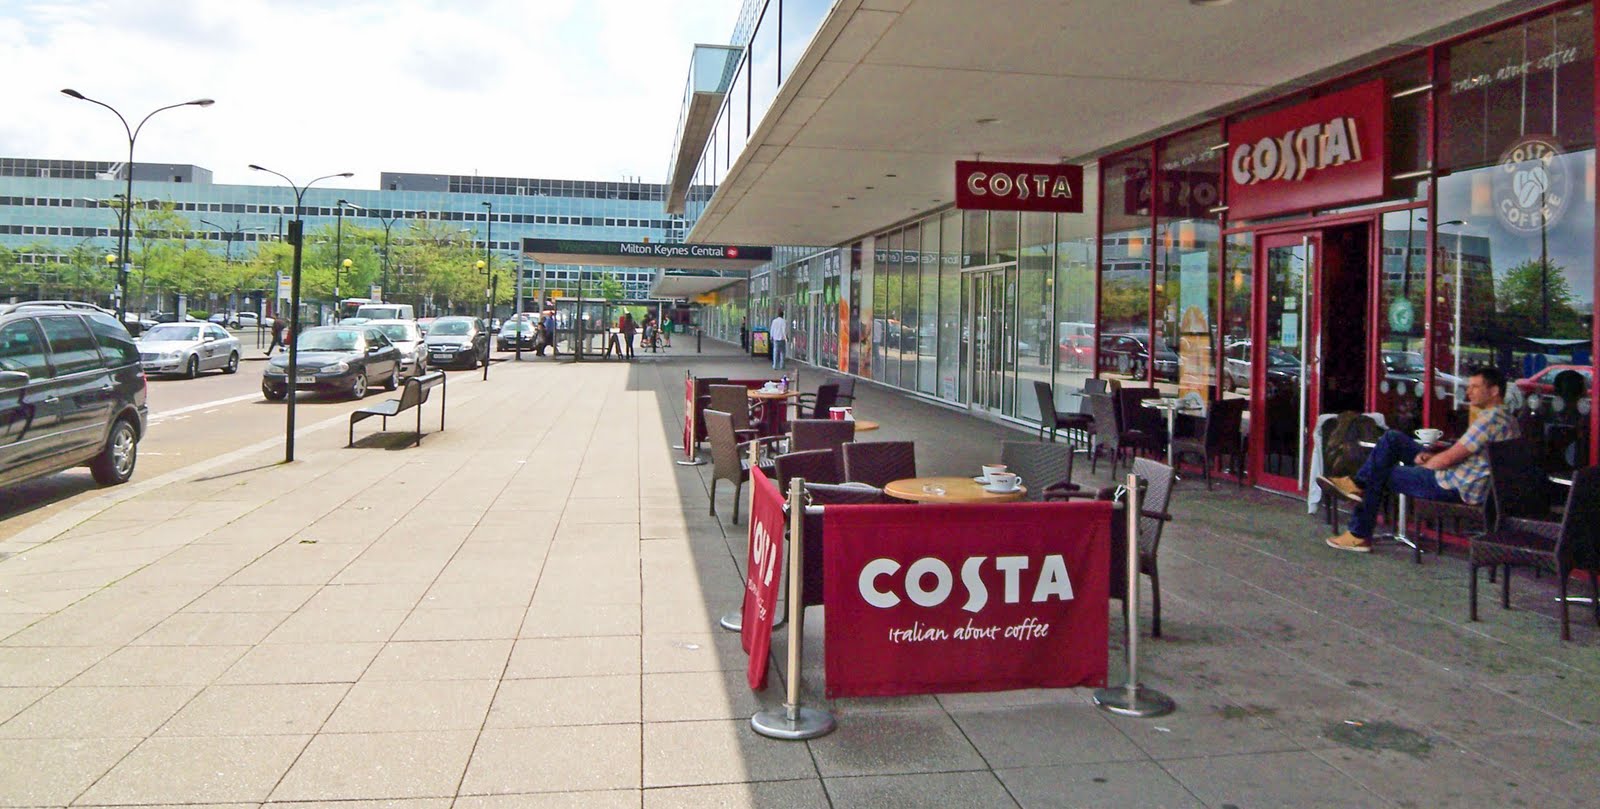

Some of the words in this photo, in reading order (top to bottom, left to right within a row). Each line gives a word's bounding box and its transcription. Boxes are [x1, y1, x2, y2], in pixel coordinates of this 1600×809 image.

[1231, 116, 1357, 185] COSTA
[1503, 144, 1555, 173] COSTA
[967, 171, 1072, 200] COSTA
[1501, 193, 1561, 227] COFFEE
[620, 243, 652, 254] Milton
[654, 244, 689, 257] Keynes
[691, 245, 724, 256] Central
[858, 554, 1075, 613] COSTA
[888, 621, 949, 643] Italian
[953, 618, 1001, 640] about
[1004, 617, 1050, 641] coffee
